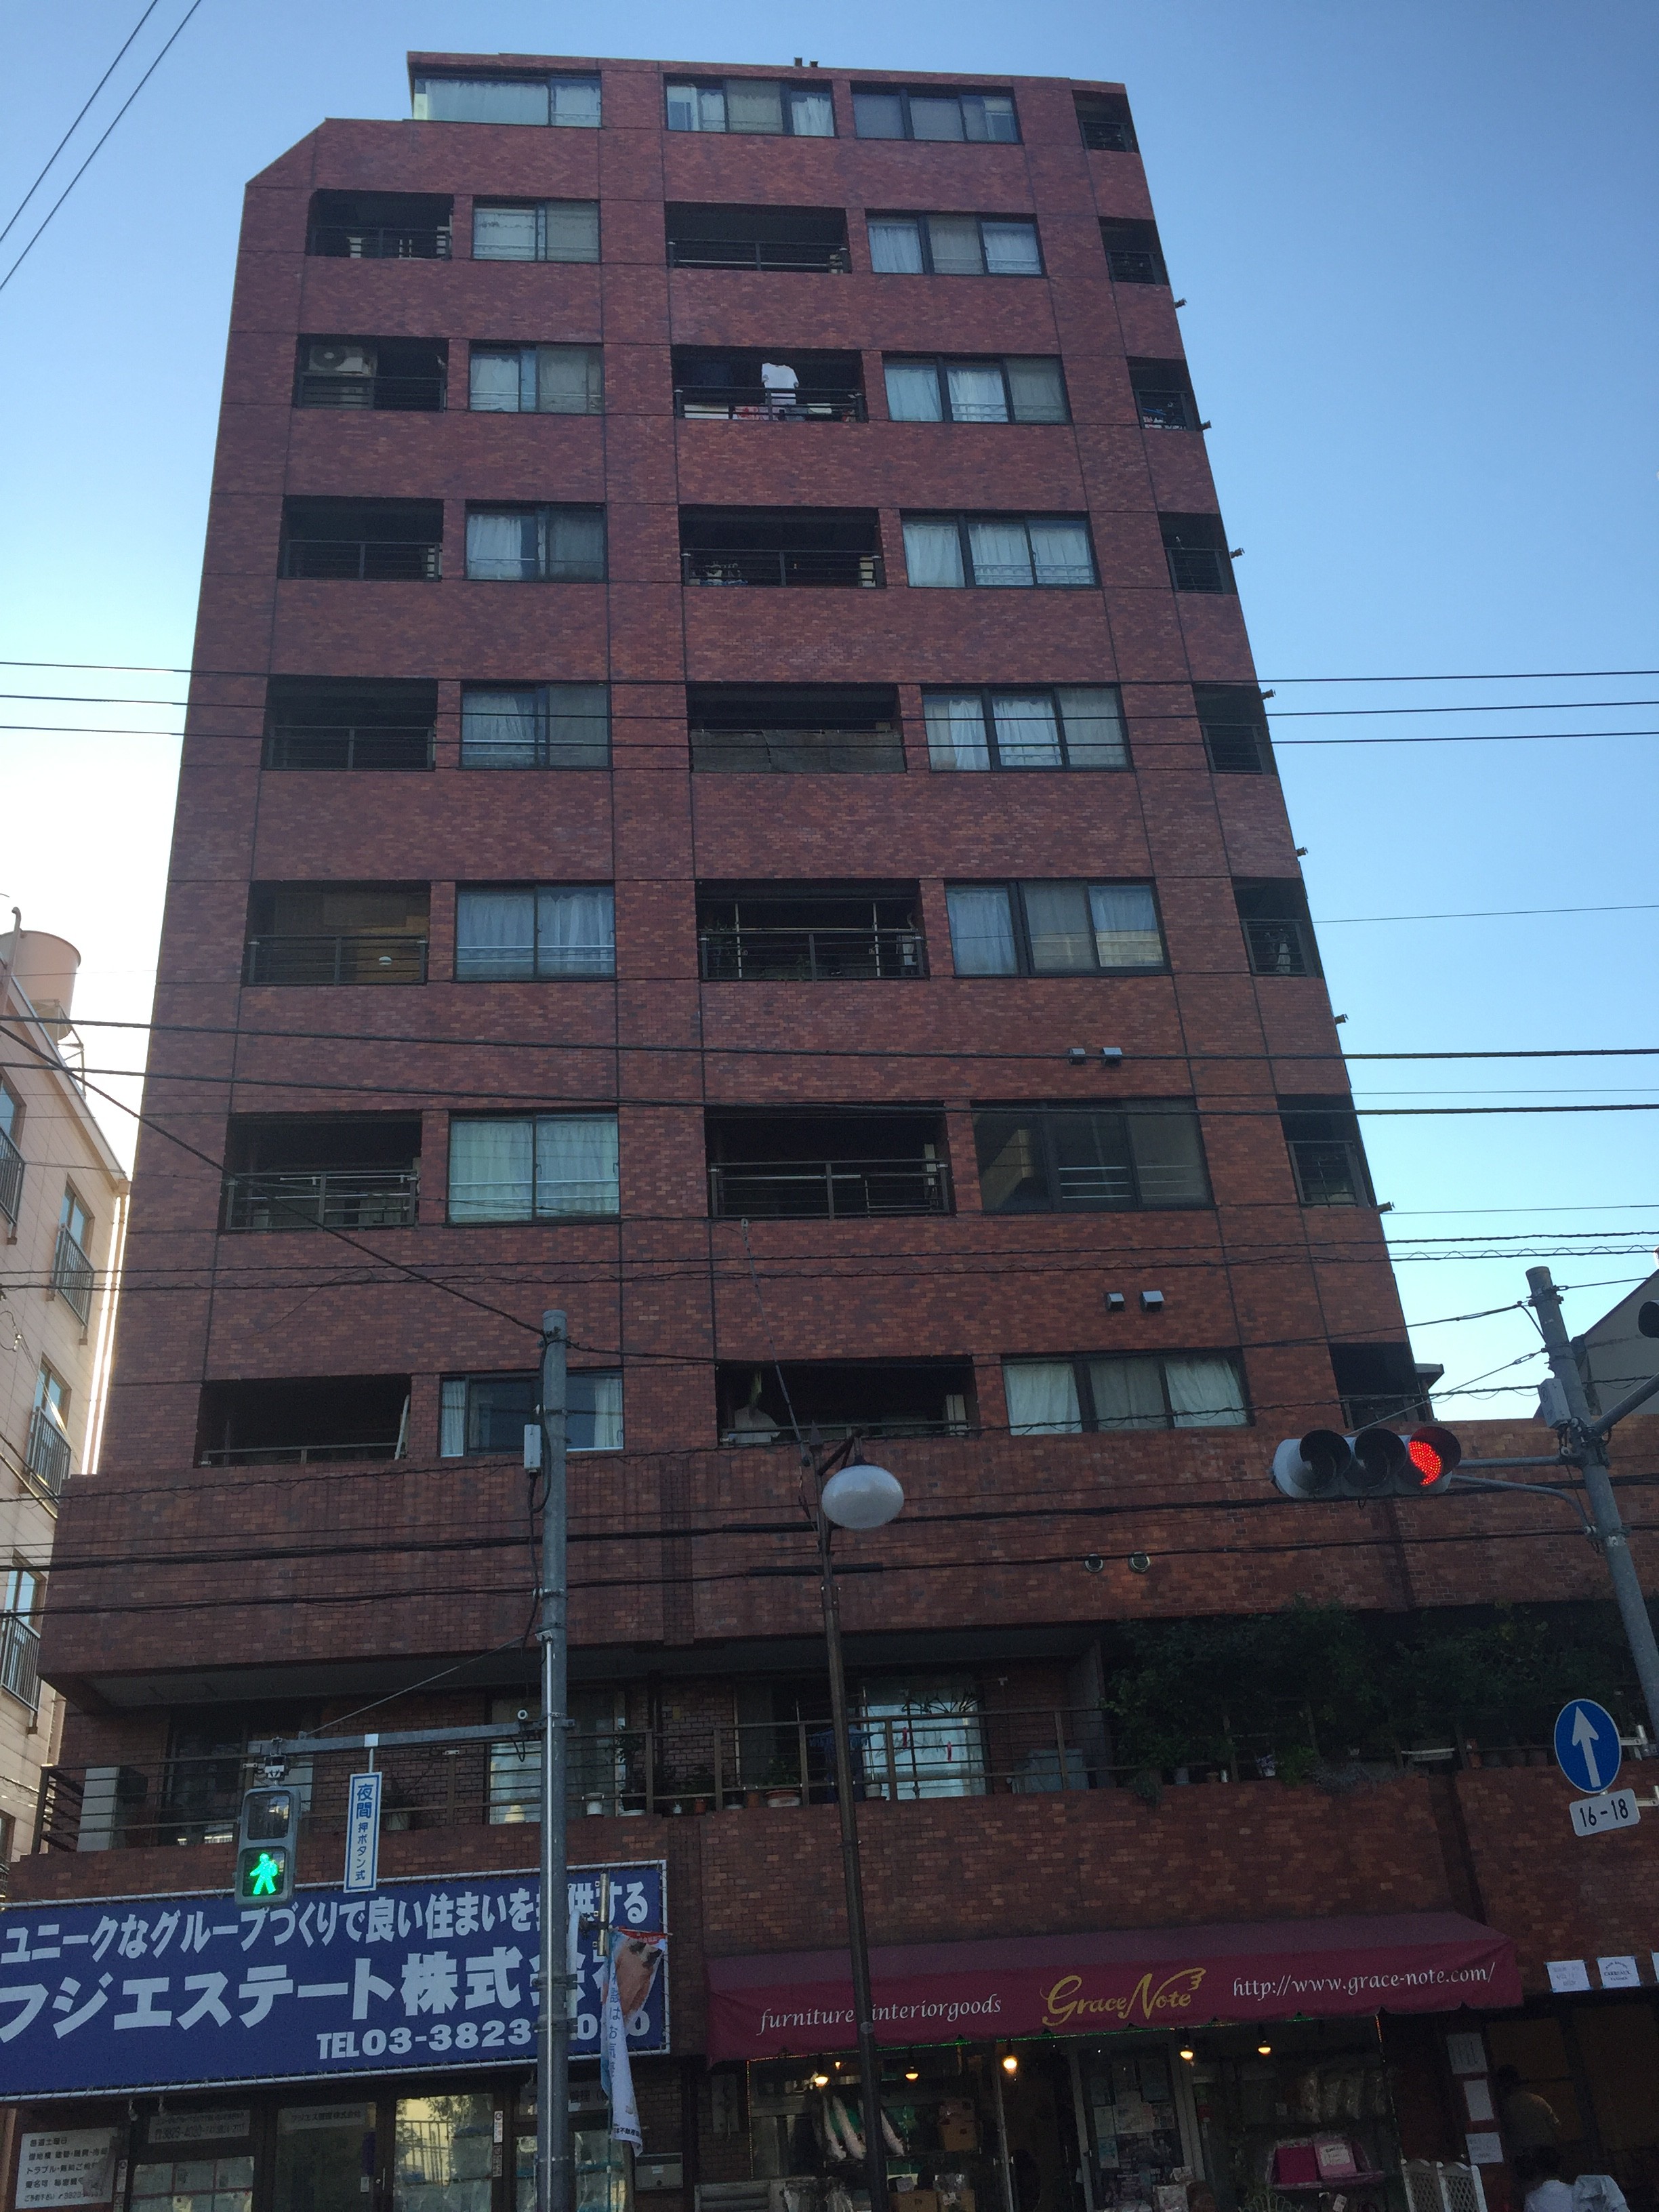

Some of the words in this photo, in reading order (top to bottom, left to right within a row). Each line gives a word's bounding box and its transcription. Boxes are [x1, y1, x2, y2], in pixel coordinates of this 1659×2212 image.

[354, 1783, 374, 1881] 夜間押ボタン式
[1579, 1797, 1629, 1828] 16-18
[1, 1881, 649, 1964] ユニークなグループづくりで良い住まいを供する
[0, 1945, 607, 2043] フジエステート株式
[1233, 1962, 1496, 2001] http://www.grace-note.com/
[756, 2007, 855, 2036] furniture
[872, 1993, 1002, 2023] interiorgoods
